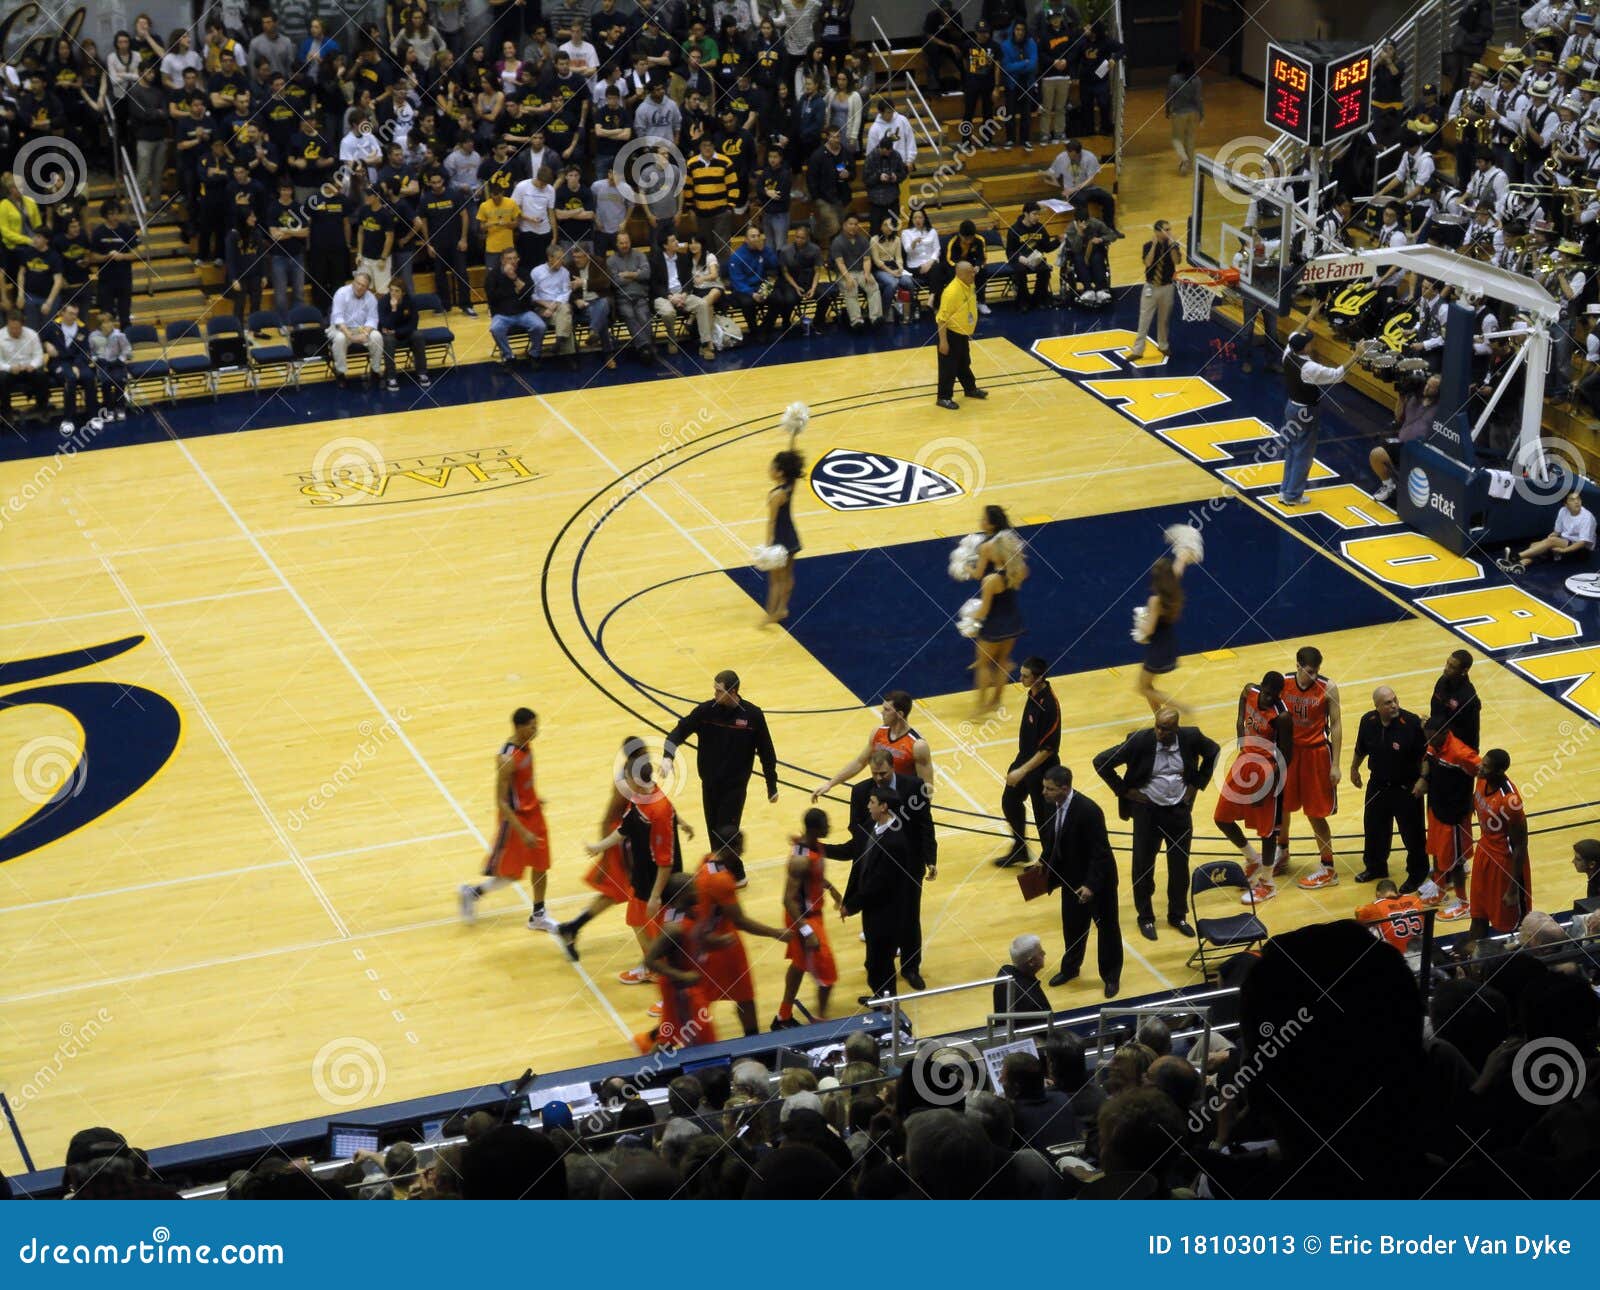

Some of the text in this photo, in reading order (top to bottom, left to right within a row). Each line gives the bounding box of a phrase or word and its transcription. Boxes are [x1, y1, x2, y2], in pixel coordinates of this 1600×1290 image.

[1274, 58, 1307, 92] 15:53
[1334, 58, 1369, 91] 15:53
[1273, 88, 1301, 128] 35
[1333, 89, 1362, 129] 35
[722, 138, 743, 156] Cal
[1302, 262, 1364, 281] ate Farm
[1329, 282, 1378, 316] Cal
[1430, 492, 1456, 520] at&t
[1388, 909, 1425, 938] 55
